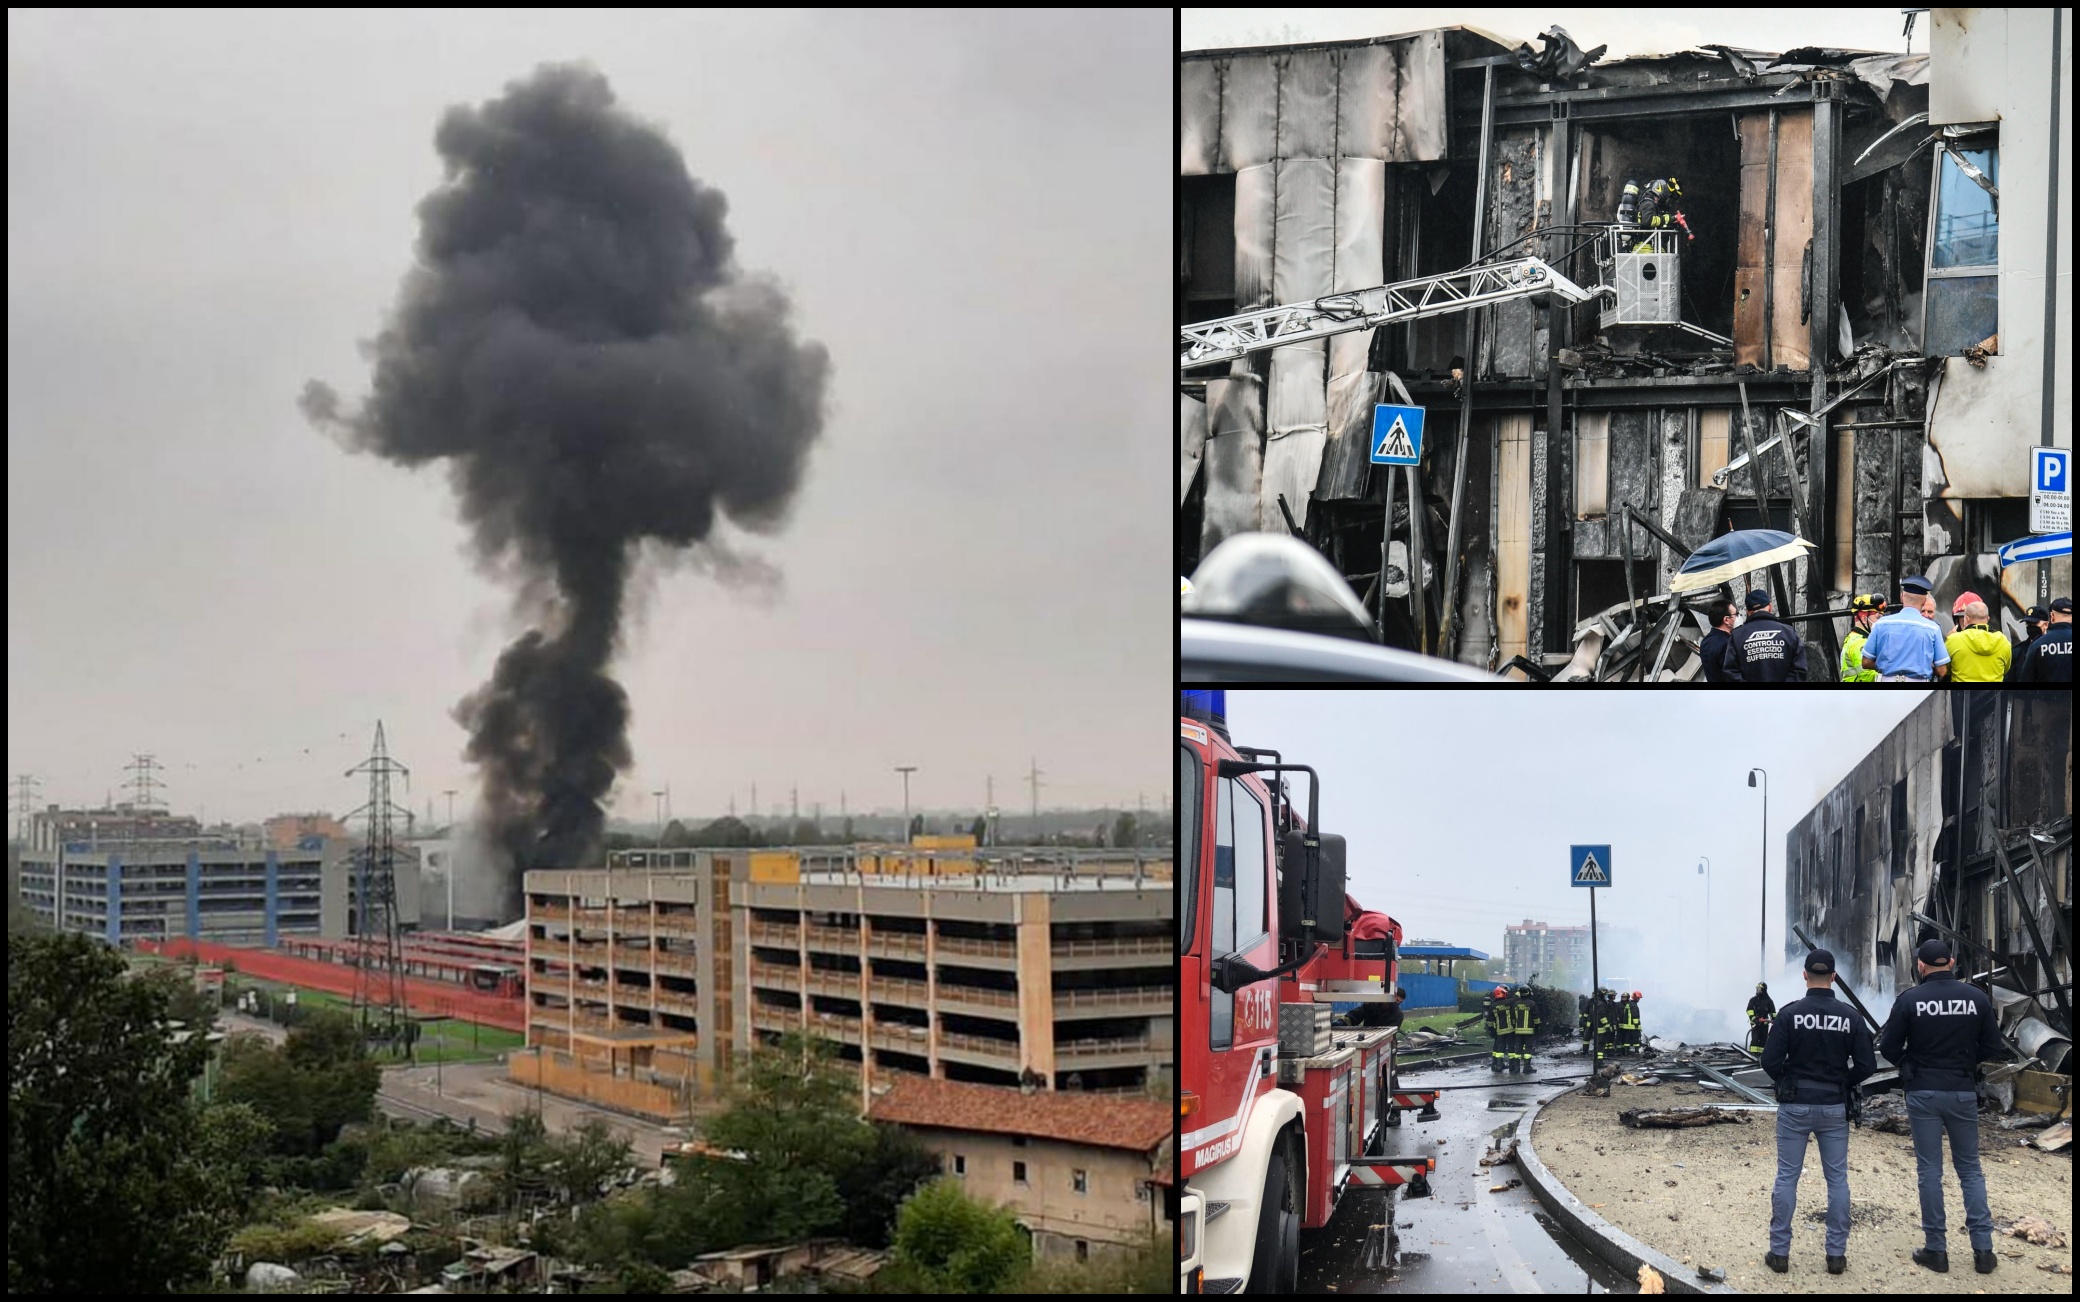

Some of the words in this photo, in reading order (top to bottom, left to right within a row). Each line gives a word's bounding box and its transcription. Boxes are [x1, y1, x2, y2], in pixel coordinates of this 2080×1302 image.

[2044, 456, 2061, 487] P
[1743, 640, 1785, 650] CONTROLLO
[1747, 646, 1782, 656] ESERCIZIO
[1746, 652, 1784, 663] SUPERFICIE
[1255, 988, 1272, 1030] 115
[1916, 999, 1977, 1017] POLIZIA
[1793, 1013, 1851, 1034] POLIZIA
[1195, 1137, 1232, 1169] MAGIRUS
